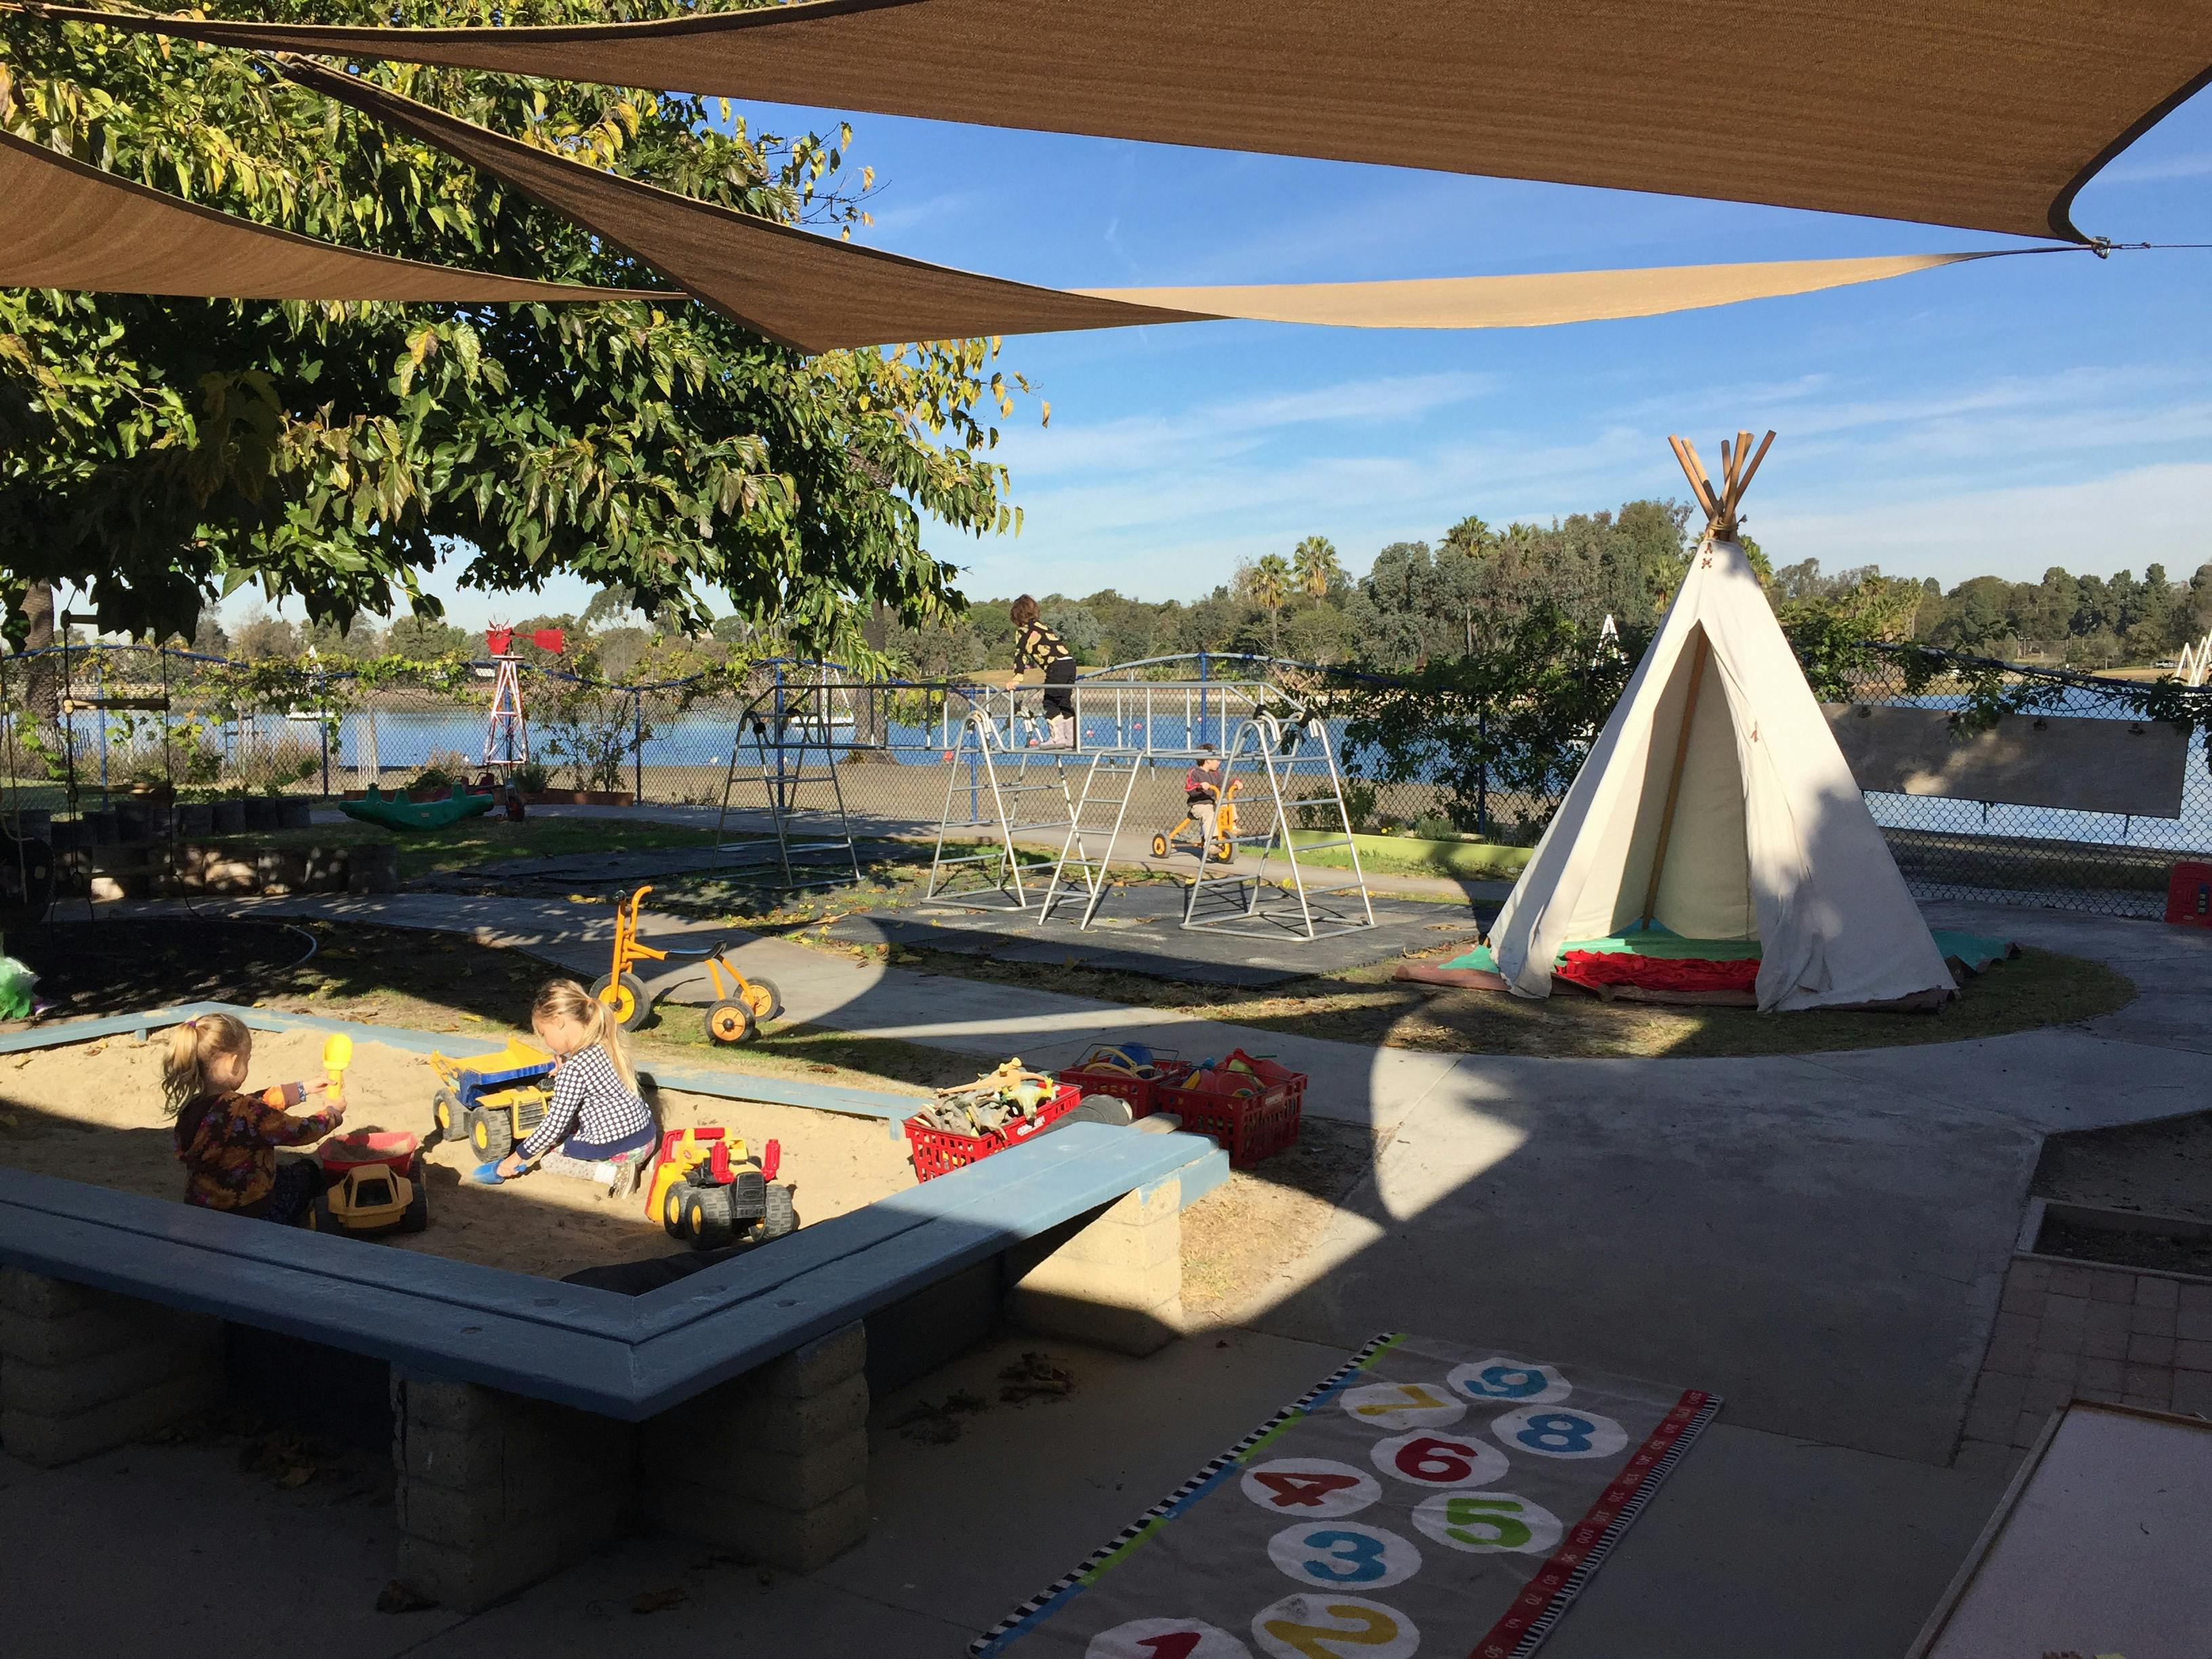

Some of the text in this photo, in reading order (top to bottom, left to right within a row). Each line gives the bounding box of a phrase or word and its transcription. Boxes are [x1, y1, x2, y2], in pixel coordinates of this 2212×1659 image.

[1356, 1385, 1449, 1415] 7
[1463, 1366, 1547, 1398] 9
[1517, 1413, 1596, 1452] 8
[1395, 1437, 1478, 1482] 6
[1254, 1471, 1360, 1507] 4
[1444, 1498, 1532, 1548] 5
[1576, 1528, 1594, 1544] 100
[1303, 1530, 1387, 1582] 3
[1543, 1574, 1559, 1585] 80
[1525, 1593, 1542, 1605] 70
[1263, 1605, 1398, 1659] 2
